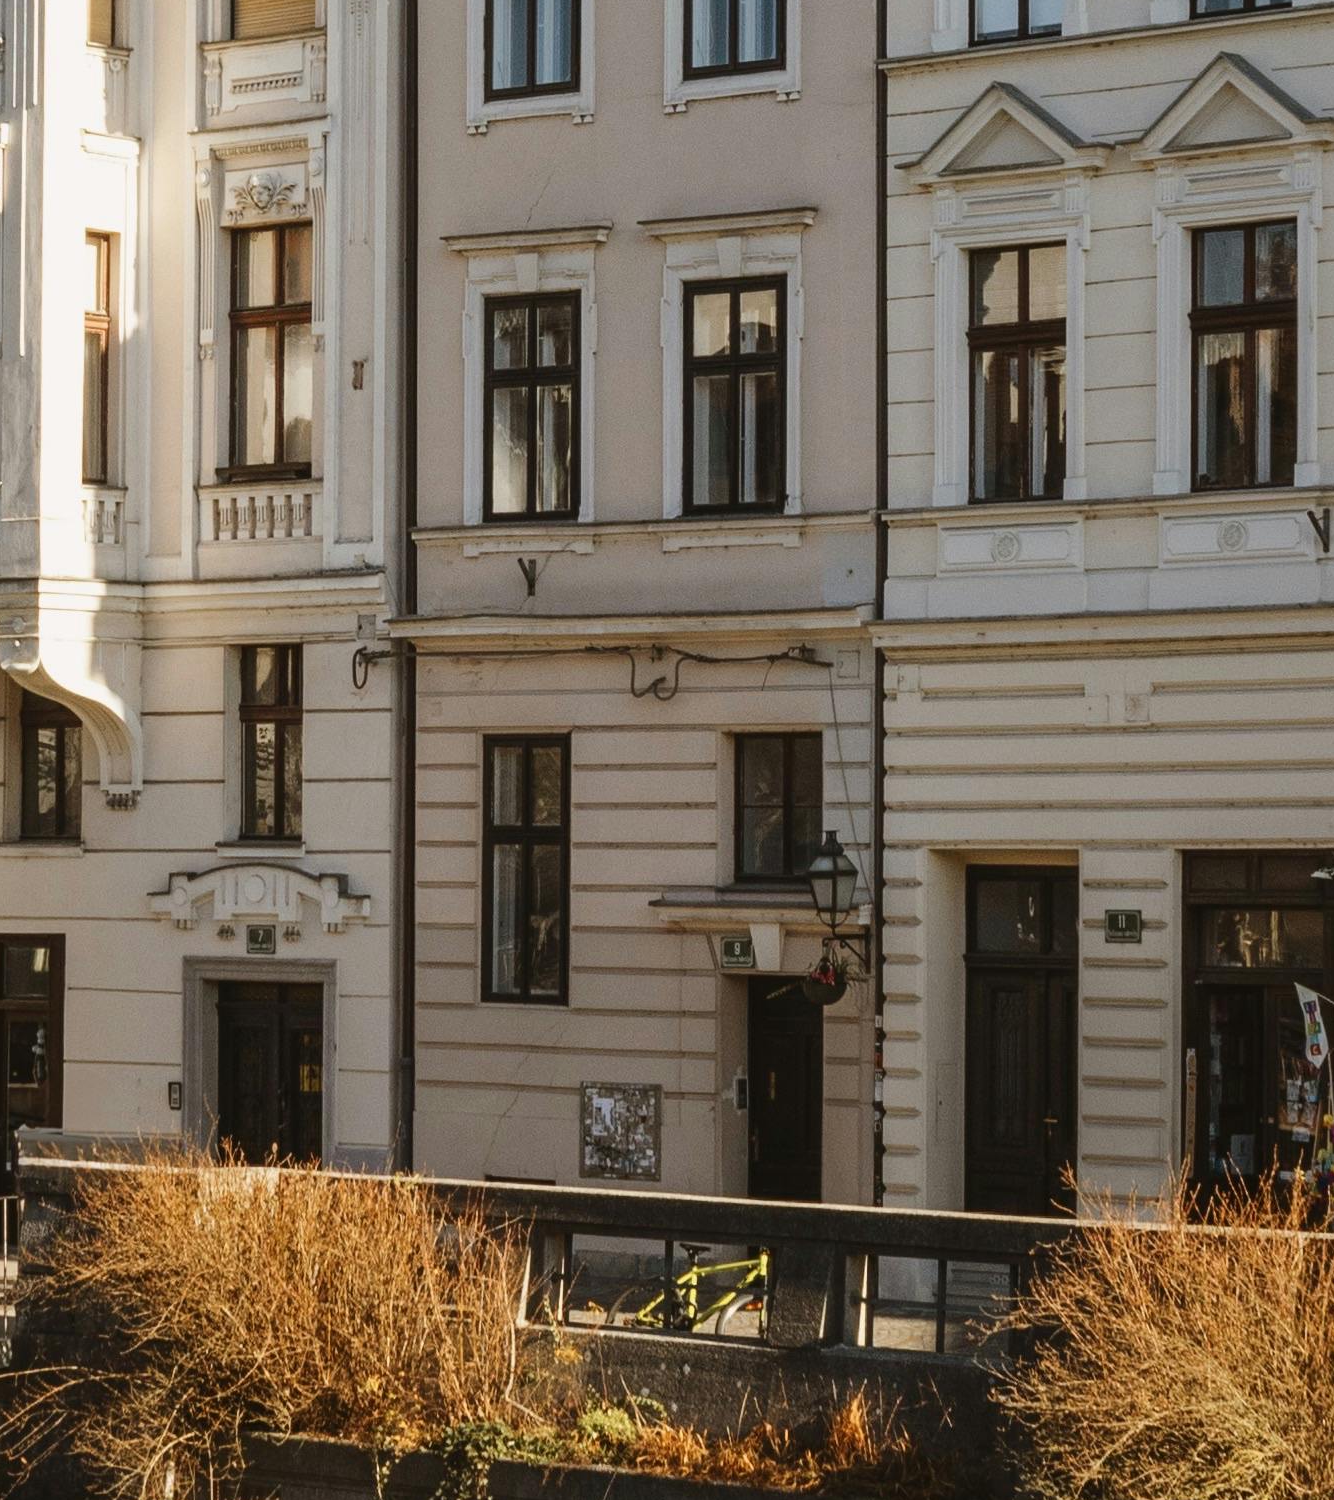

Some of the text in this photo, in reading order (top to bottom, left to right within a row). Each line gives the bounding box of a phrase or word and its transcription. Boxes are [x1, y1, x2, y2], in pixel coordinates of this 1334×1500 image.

[1118, 914, 1125, 928] 11
[258, 930, 264, 942] 7
[734, 942, 740, 955] 9
